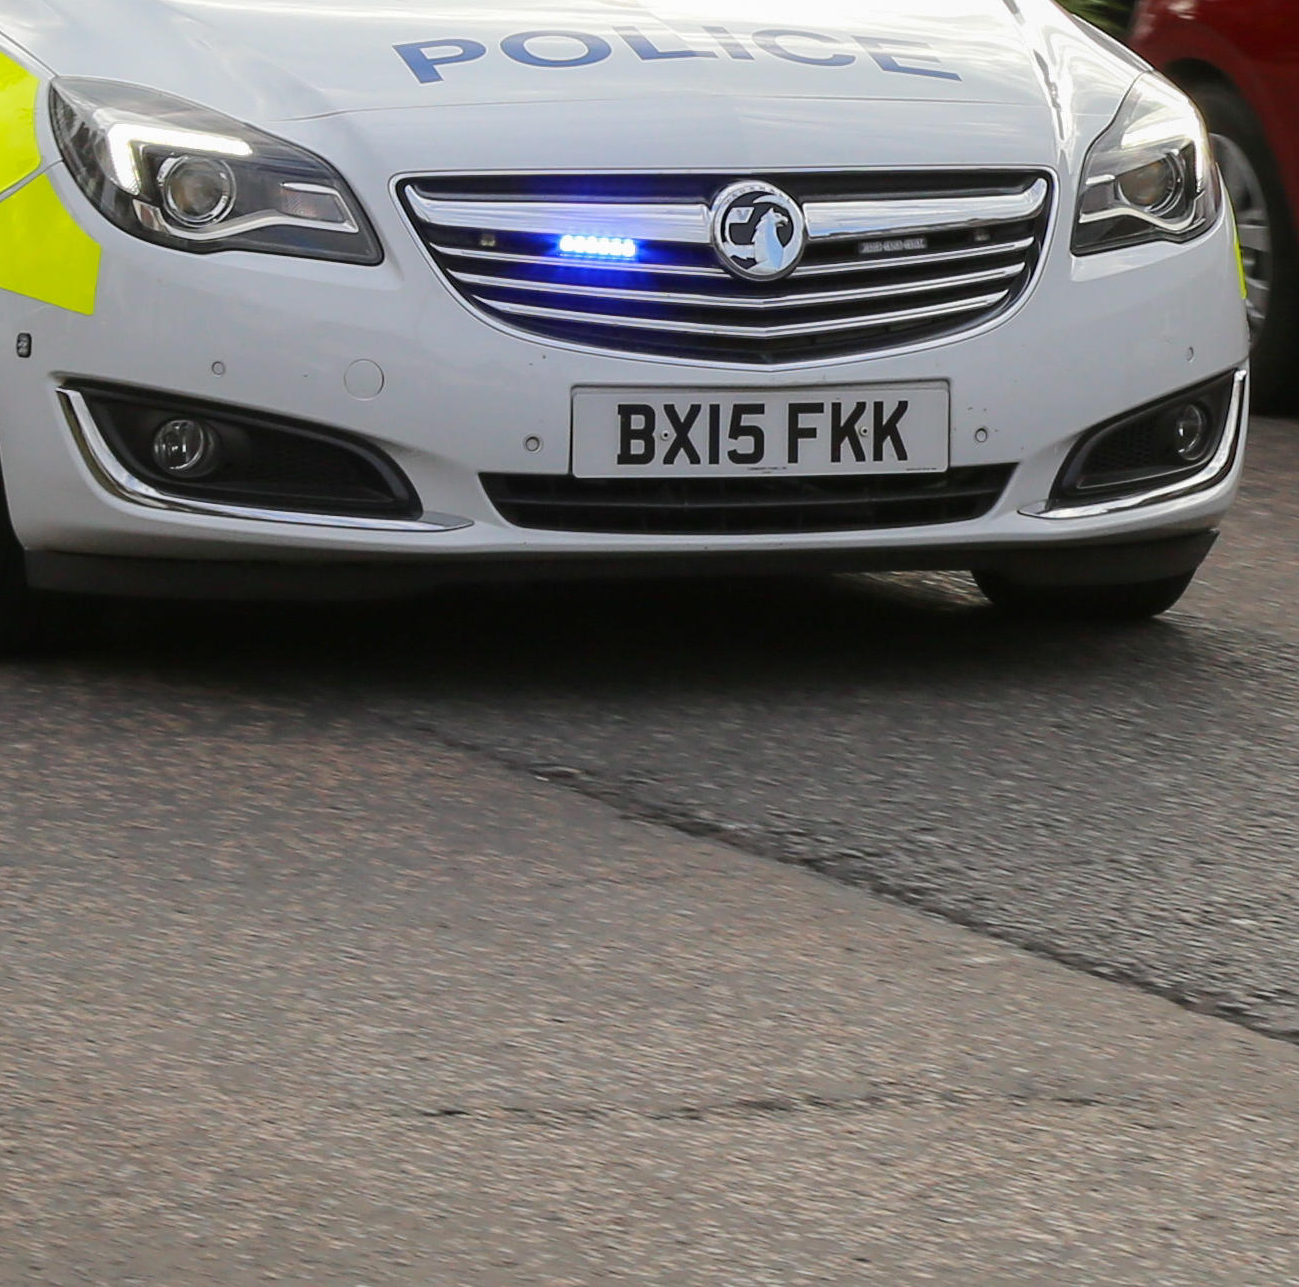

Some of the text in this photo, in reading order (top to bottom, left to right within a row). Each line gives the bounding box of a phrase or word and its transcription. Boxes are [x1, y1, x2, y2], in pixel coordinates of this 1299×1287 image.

[391, 25, 963, 84] POLICE
[617, 400, 908, 465] BX15 FKK
